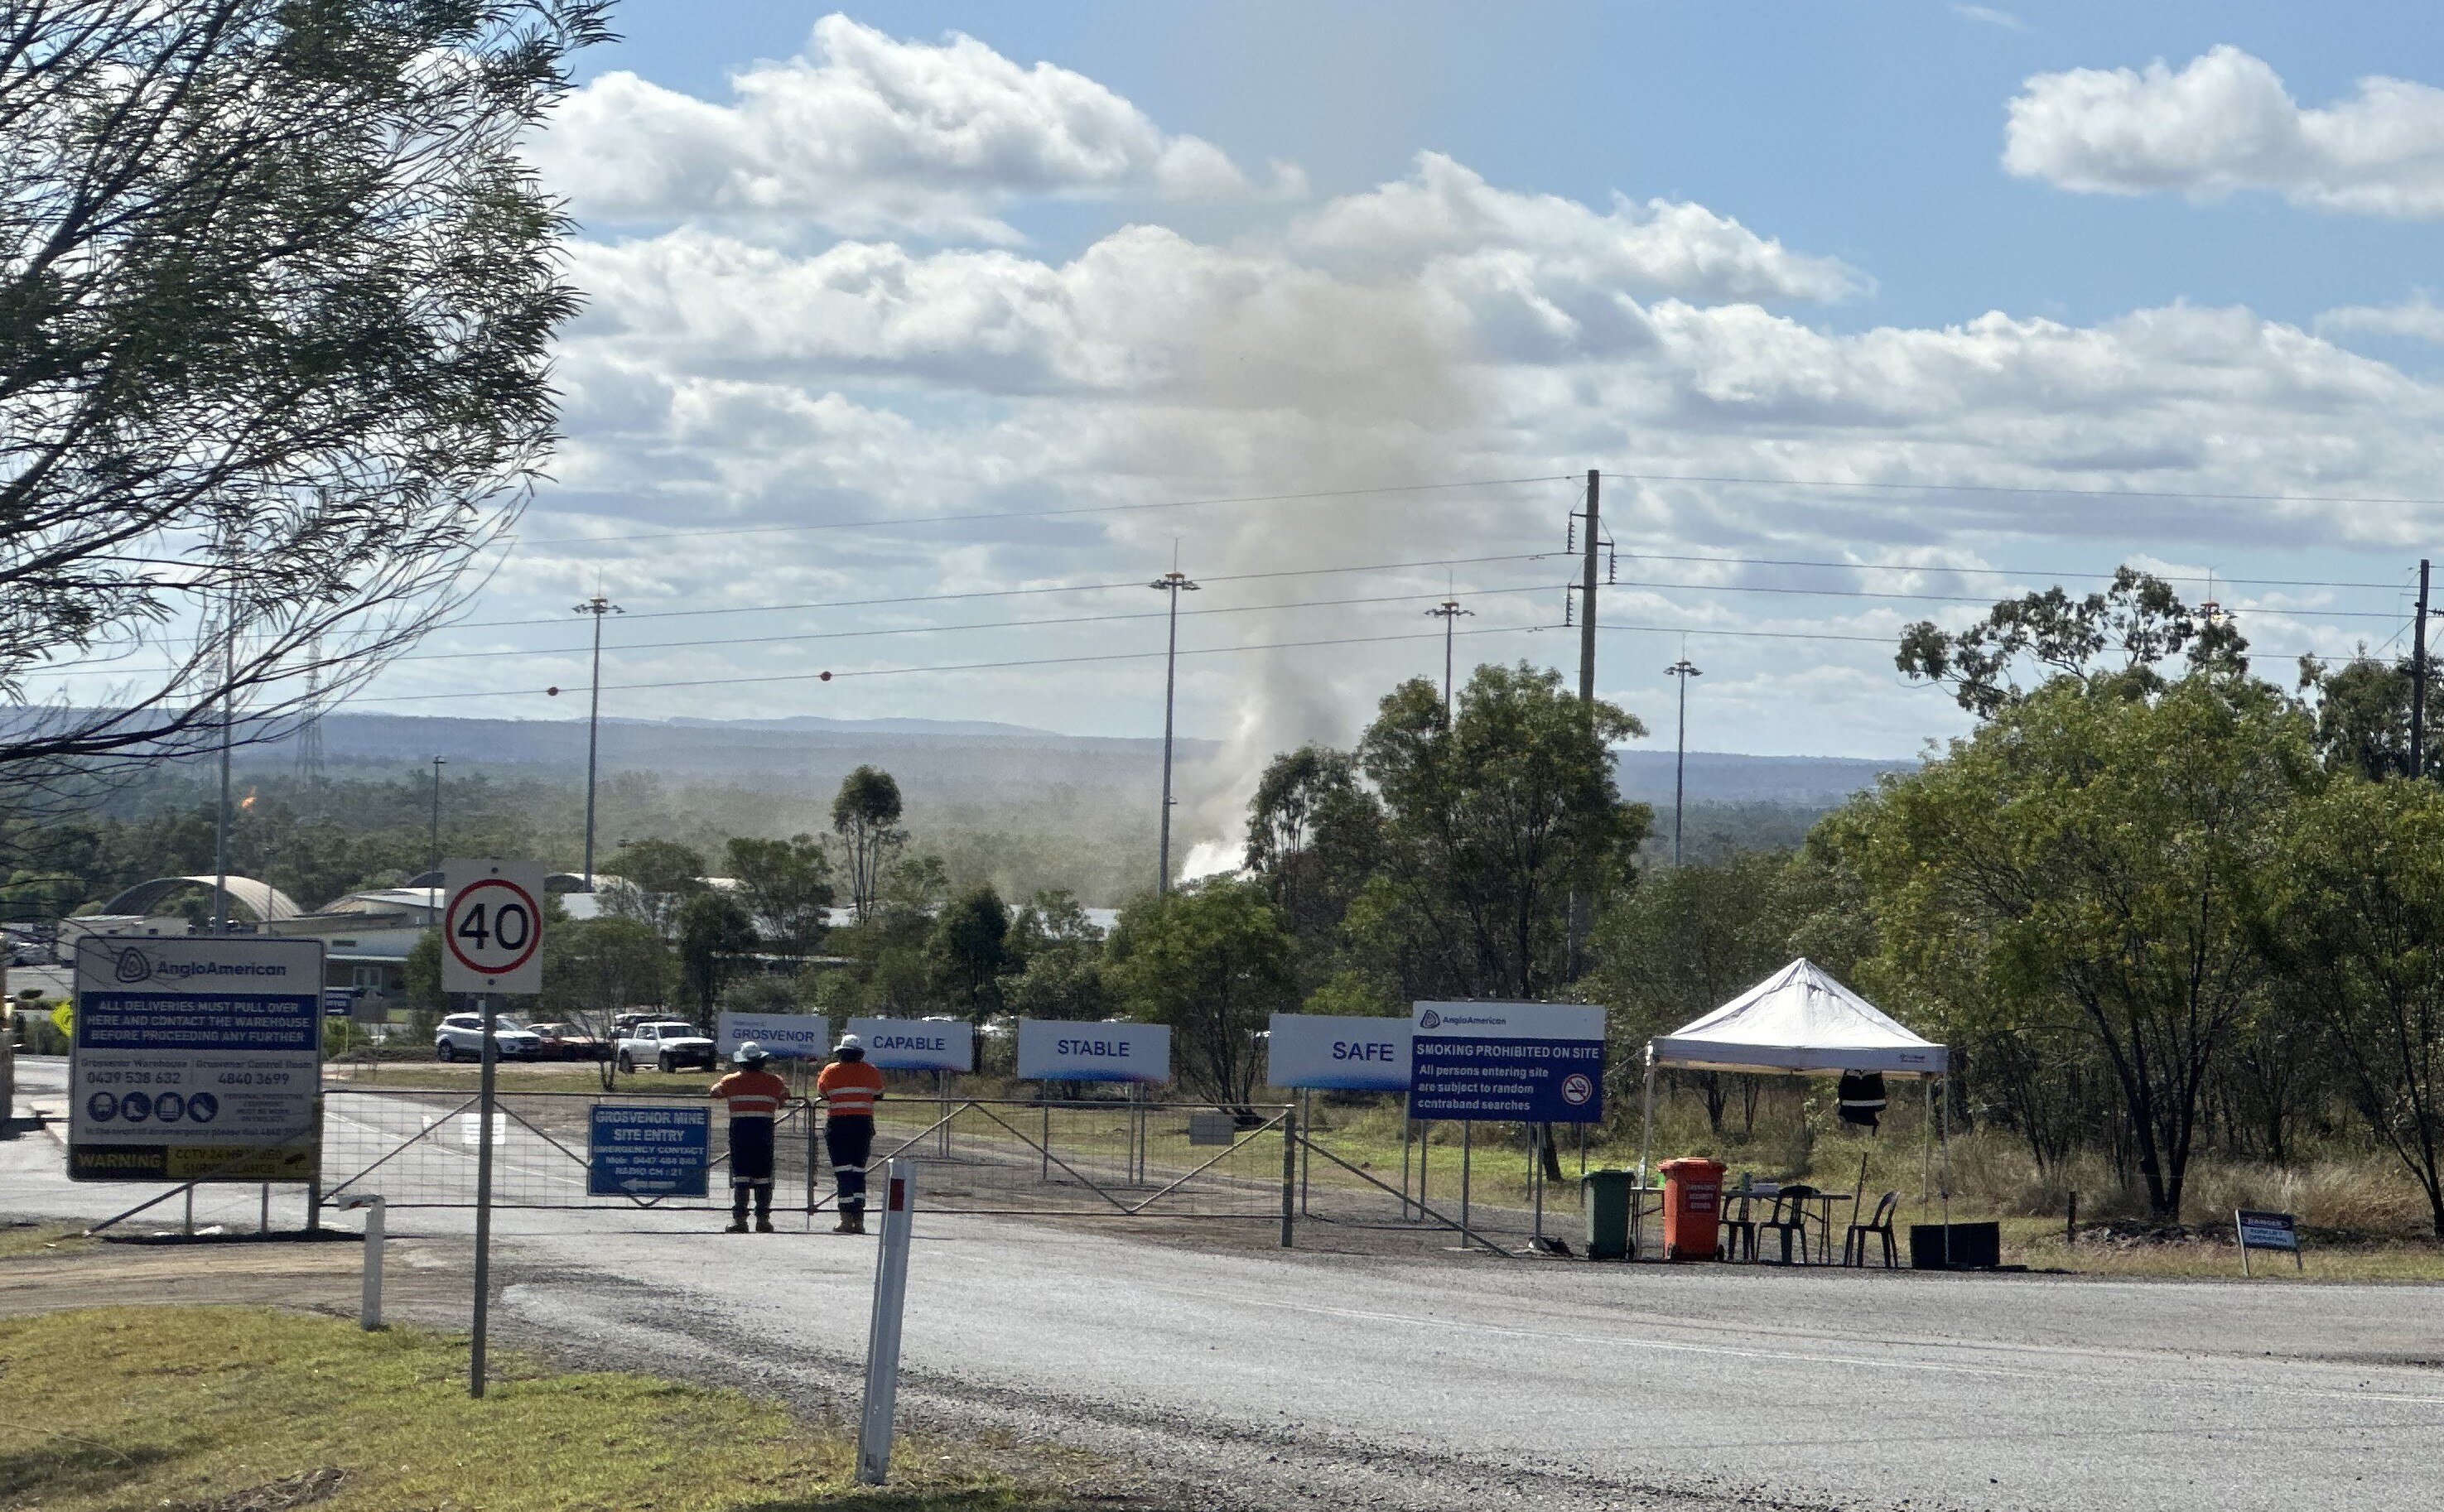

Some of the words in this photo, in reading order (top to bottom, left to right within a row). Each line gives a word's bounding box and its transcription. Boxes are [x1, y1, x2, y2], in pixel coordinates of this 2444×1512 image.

[458, 903, 529, 951] 40
[157, 961, 287, 977] AngloAmerican
[99, 1001, 121, 1011] ALL
[126, 1001, 195, 1012] DELIVERIES
[198, 1002, 231, 1012] MUST
[234, 1002, 264, 1013] PULL
[268, 1003, 298, 1013] OVER
[87, 1015, 119, 1025] HERE
[123, 1015, 147, 1025] AND
[152, 1015, 207, 1026] CONTACT
[210, 1016, 232, 1026] THE
[235, 1017, 310, 1027] WAREHOUSE
[1443, 1014, 1506, 1026] AngloAmerican
[90, 1030, 139, 1040] BEFORE
[142, 1030, 220, 1041] PROCEEDING
[222, 1031, 246, 1041] ANY
[248, 1031, 304, 1042] FURTHER
[732, 1028, 815, 1042] GROSVENOR
[873, 1035, 946, 1051] CAPABLE
[1058, 1039, 1130, 1057] STABLE
[1333, 1041, 1395, 1062] SAFE
[1416, 1044, 1473, 1057] SMOKING
[1475, 1045, 1550, 1058] PROHIBITED
[1551, 1046, 1570, 1058] ON
[1572, 1046, 1599, 1059] SITE
[87, 1071, 122, 1083] 0439
[156, 1072, 181, 1084] 632
[218, 1072, 252, 1085] 4840
[256, 1073, 290, 1085] 3699
[1420, 1065, 1433, 1075] All
[1436, 1067, 1479, 1079] persons
[1482, 1066, 1528, 1080] entering
[1531, 1067, 1550, 1077] site
[1419, 1085, 1434, 1093] are
[1437, 1081, 1477, 1095] subject
[1480, 1083, 1490, 1094] to
[1492, 1082, 1534, 1095] random
[1418, 1099, 1478, 1110] contraband
[1482, 1100, 1531, 1111] searches
[595, 1111, 672, 1124] GROSVENOR
[674, 1112, 705, 1124] MINE
[614, 1129, 641, 1141] SITE
[644, 1129, 685, 1141] ENTRY
[175, 1148, 205, 1159] CCTV
[593, 1145, 655, 1153] EMERGENCY
[658, 1147, 705, 1155] CONTACT
[78, 1153, 161, 1168] WARNING
